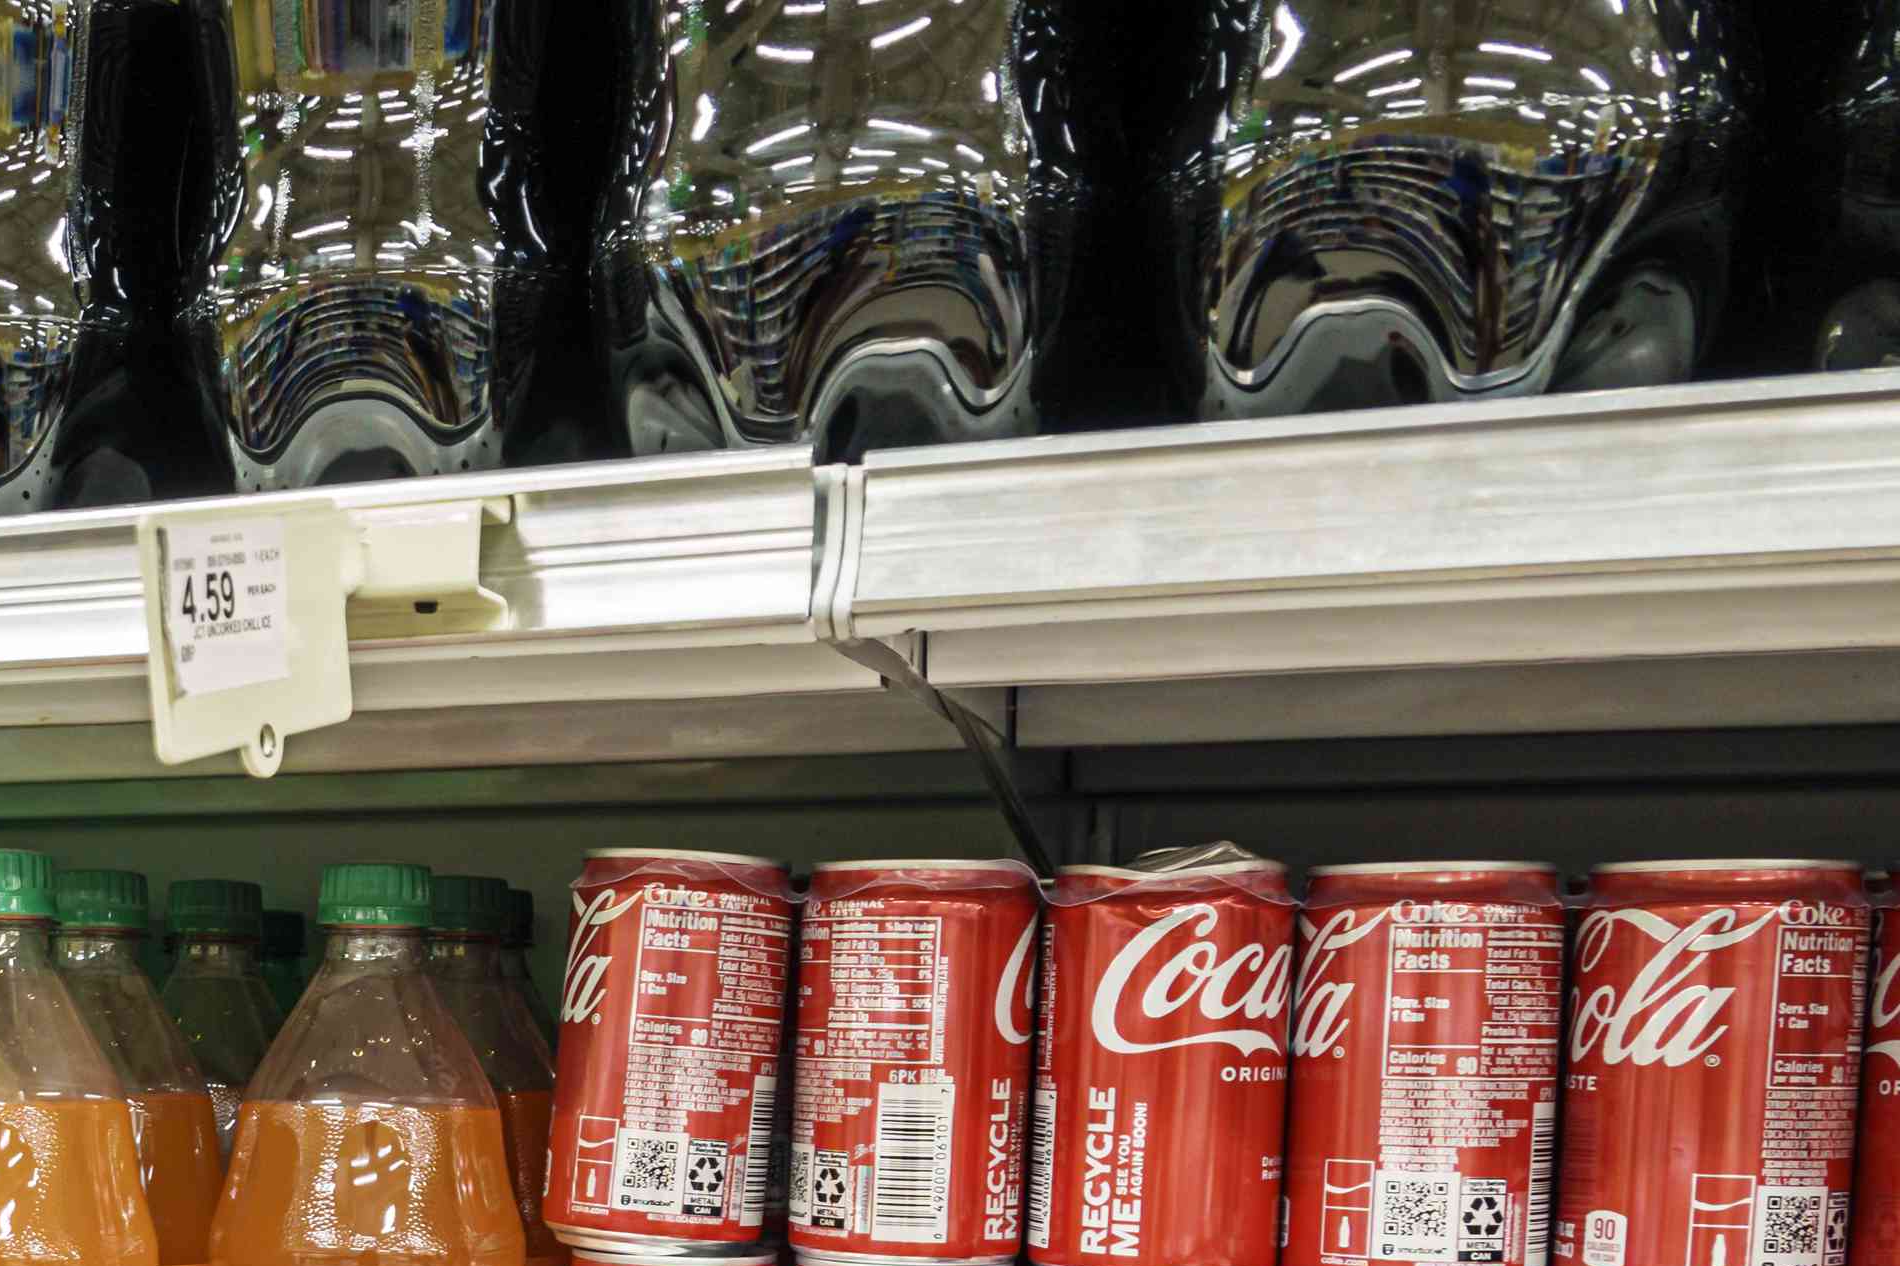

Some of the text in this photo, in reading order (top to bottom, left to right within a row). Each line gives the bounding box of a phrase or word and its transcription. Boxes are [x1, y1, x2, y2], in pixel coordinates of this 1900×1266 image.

[182, 570, 235, 623] 4.59
[645, 909, 718, 932] Nutrition
[1779, 899, 1846, 928] Coke
[644, 930, 691, 949] Facts
[1394, 927, 1483, 950] Nutrition
[1784, 931, 1854, 953] Nutrition
[1394, 949, 1452, 970] Facts
[1782, 955, 1831, 974] Facts
[1572, 908, 1784, 1067] ola
[635, 1019, 682, 1035] Calories
[1389, 1050, 1447, 1066] Calories
[1774, 1059, 1824, 1075] Calories
[888, 1070, 916, 1084] 6PK
[1220, 1066, 1287, 1082] ORIGIN
[983, 1077, 1012, 1241] RECYCLE
[1130, 1102, 1148, 1197] AGAIN SOON!
[1080, 1087, 1116, 1255] RECYCLE
[1116, 1135, 1131, 1196] SEE YOU
[1109, 1199, 1141, 1256] ME
[1593, 1217, 1616, 1241] 90
